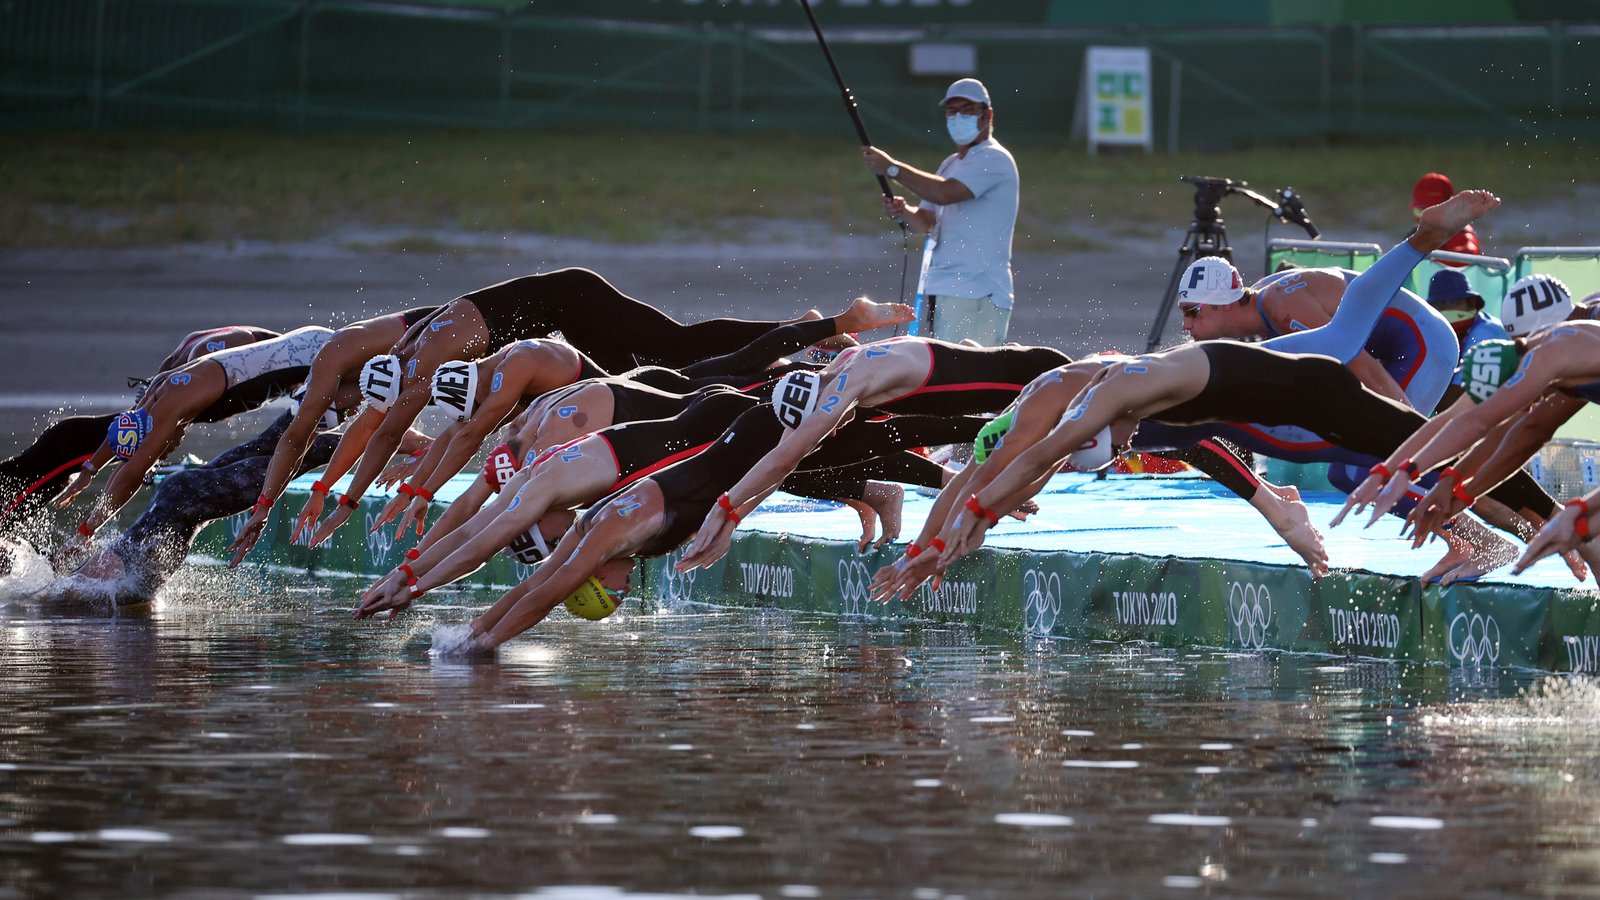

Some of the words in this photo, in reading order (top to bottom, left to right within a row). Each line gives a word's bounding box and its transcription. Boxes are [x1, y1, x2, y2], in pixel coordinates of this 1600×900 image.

[170, 372, 192, 385] 3
[366, 358, 394, 403] ITA
[435, 364, 470, 413] MEX
[1469, 346, 1502, 401] RSA
[779, 371, 815, 430] GER
[117, 413, 139, 459] ESP
[494, 452, 517, 487] BR
[510, 532, 545, 565] GE
[770, 565, 793, 598] 2020
[953, 581, 977, 614] 2020
[1112, 591, 1150, 625] TOKYO
[1150, 592, 1177, 625] 2020
[1328, 608, 1369, 646] TOKYO
[1370, 612, 1400, 649] 2020
[1562, 635, 1600, 673] TOKY
